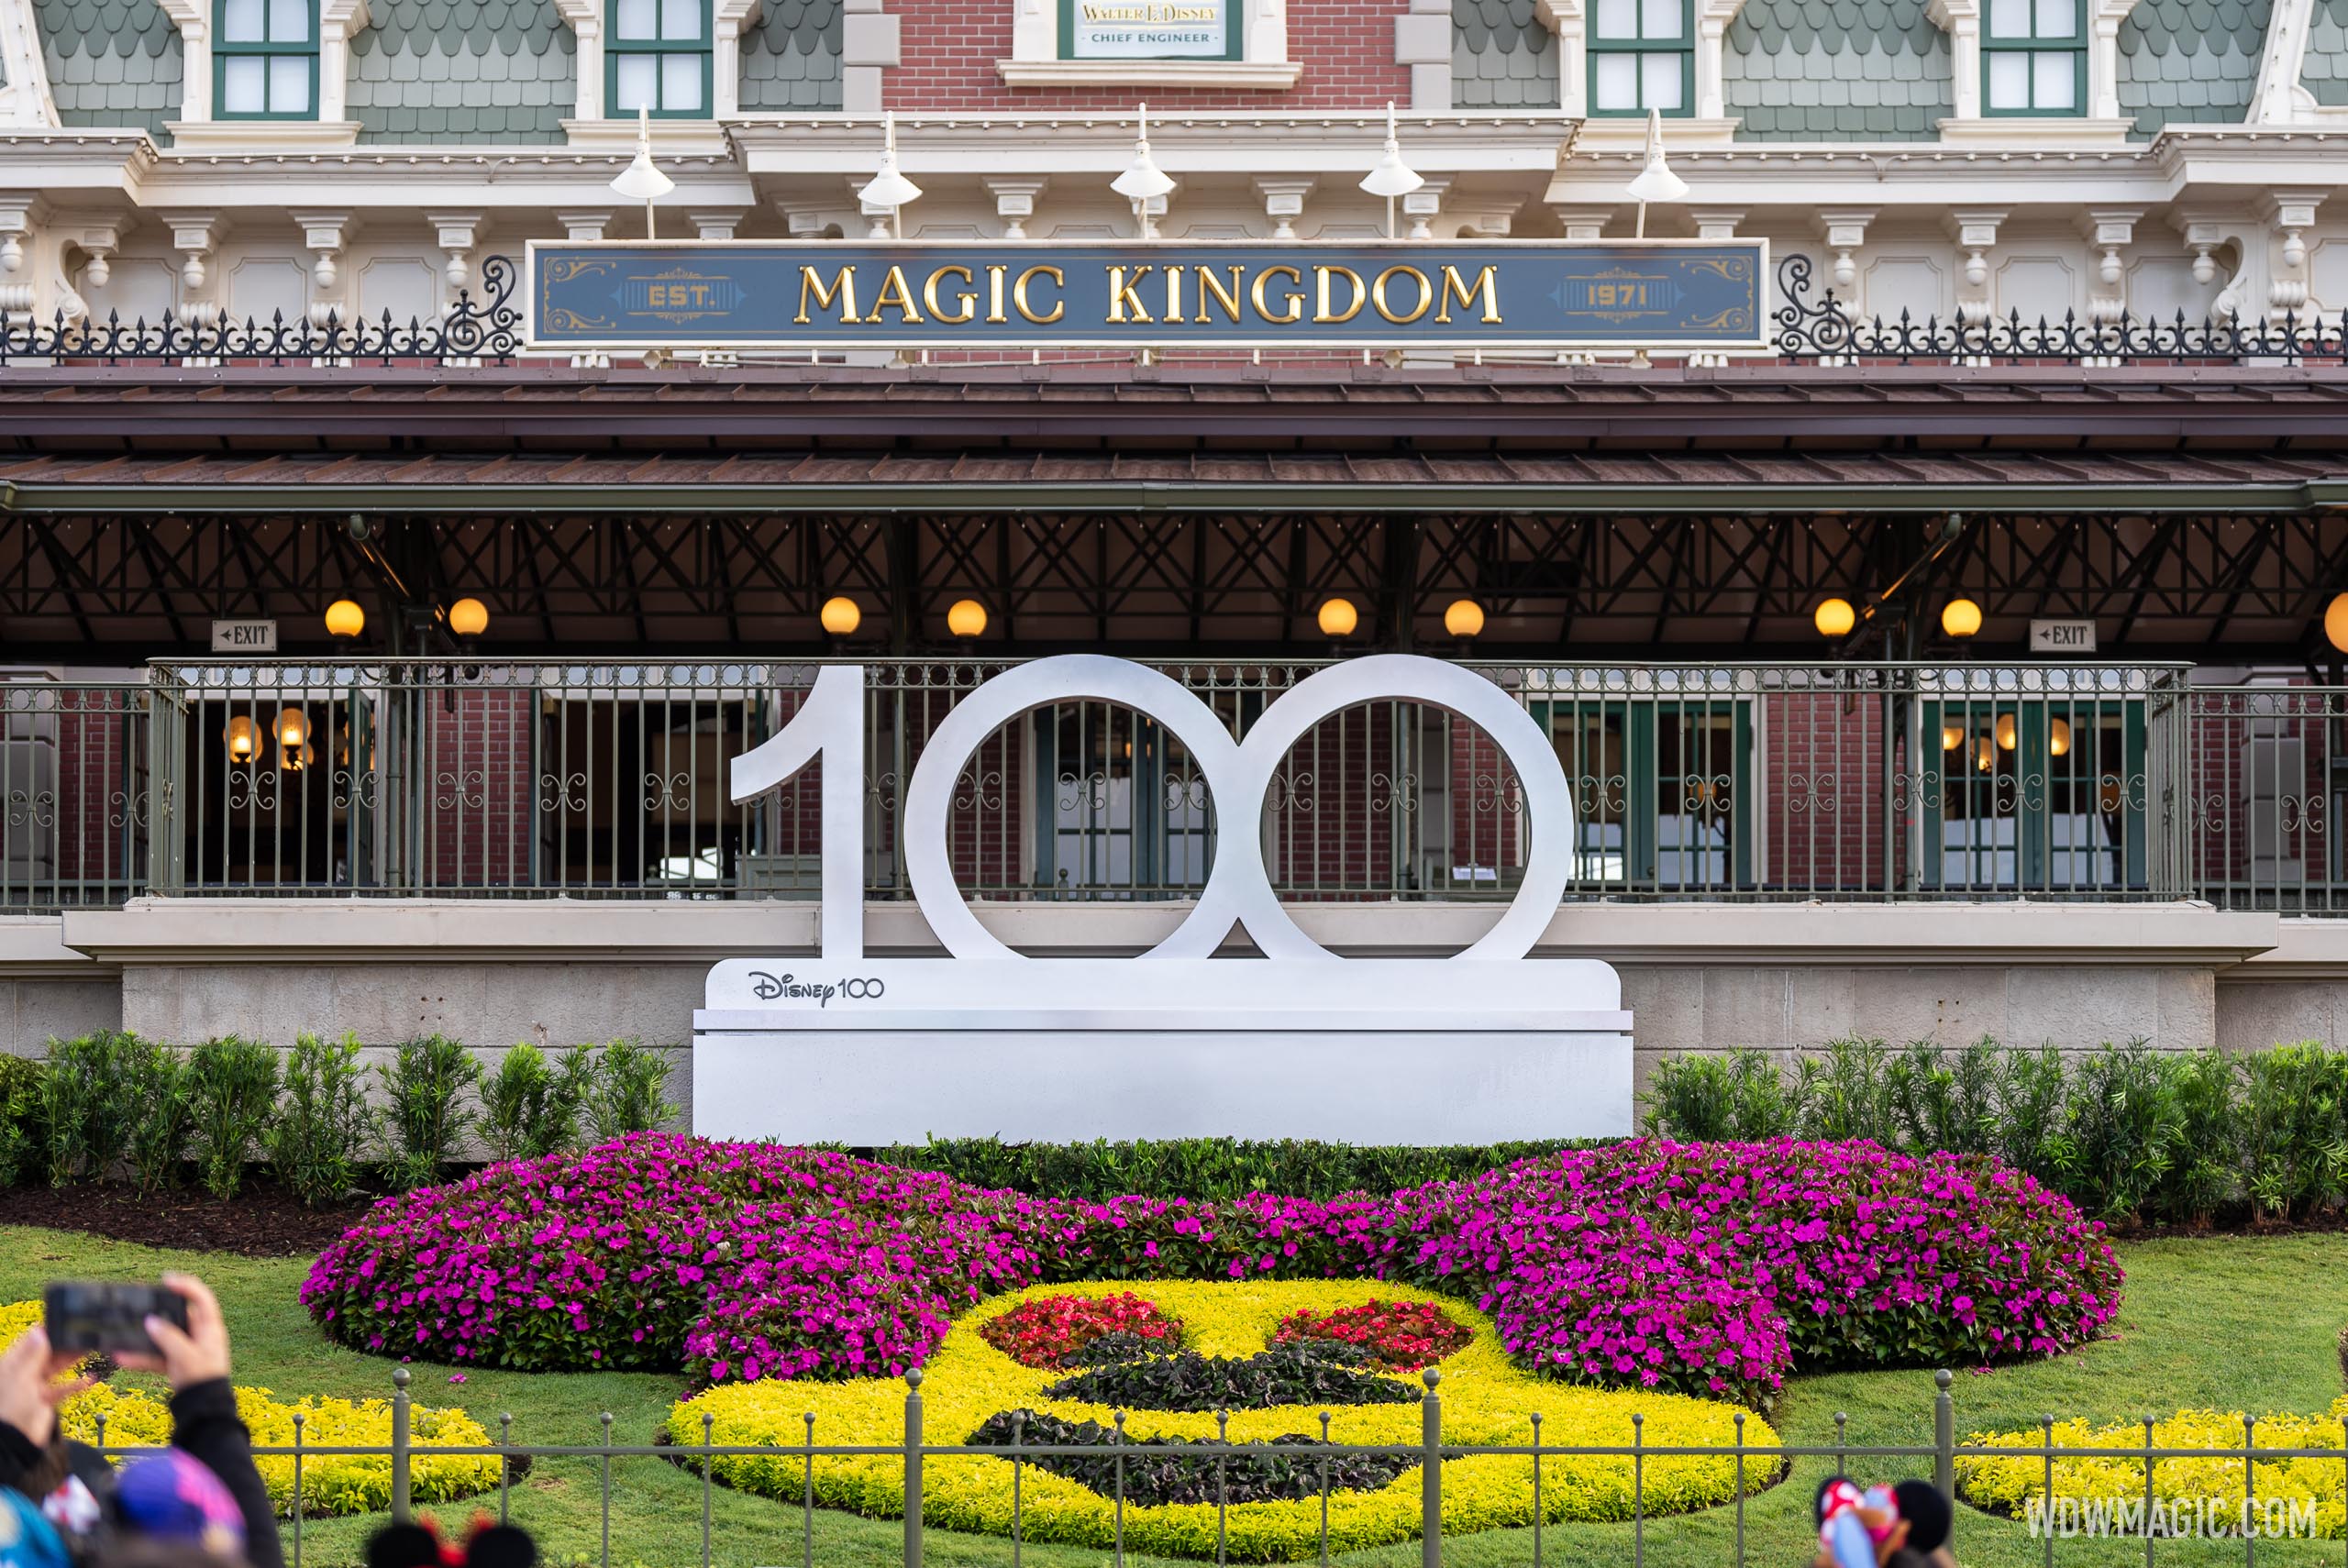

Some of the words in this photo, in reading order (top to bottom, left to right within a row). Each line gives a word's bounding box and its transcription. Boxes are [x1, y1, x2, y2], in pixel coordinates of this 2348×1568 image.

[1083, 5, 1143, 20] WALTER
[1164, 4, 1215, 21] DISNEY
[1091, 33, 1133, 42] CHIEF
[1138, 33, 1210, 42] ENGINEER
[648, 285, 715, 305] EST.
[792, 264, 1066, 326] MAGIC
[1104, 264, 1504, 325] KINGDOM
[1589, 285, 1646, 304] 1971
[234, 625, 268, 644] EXIT
[2054, 625, 2087, 644] EXIT
[731, 654, 1574, 959] 100
[748, 970, 836, 1009] Disney
[837, 977, 885, 999] 100
